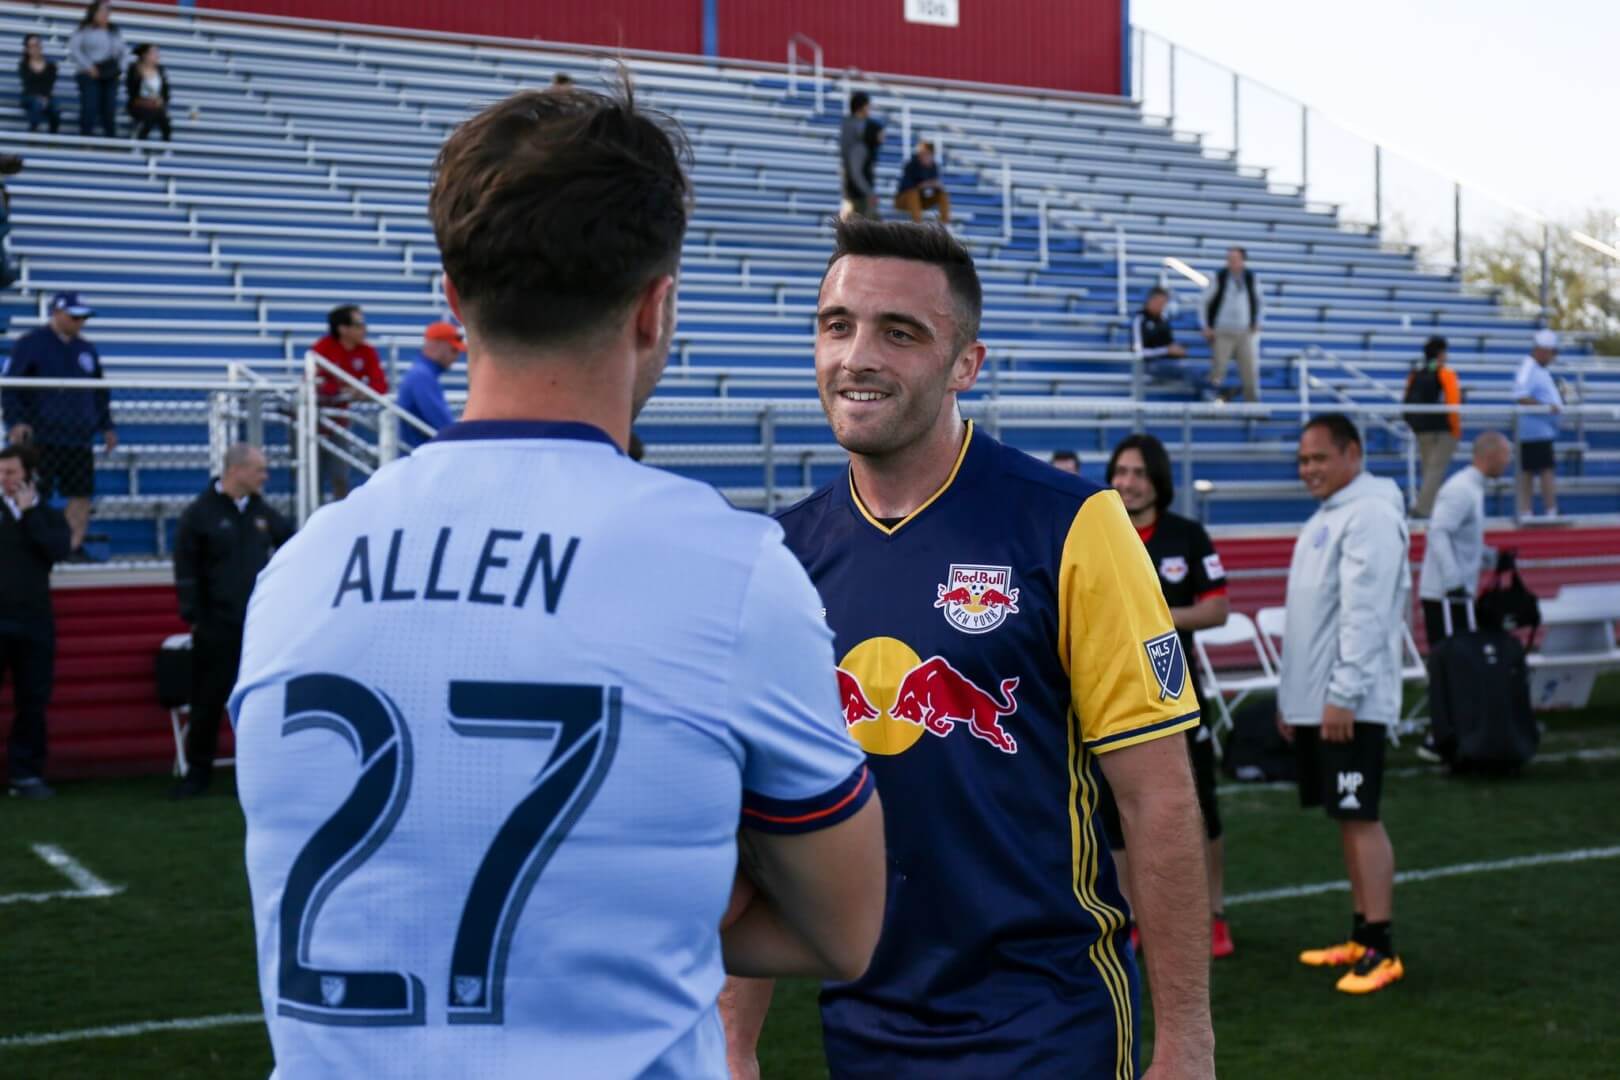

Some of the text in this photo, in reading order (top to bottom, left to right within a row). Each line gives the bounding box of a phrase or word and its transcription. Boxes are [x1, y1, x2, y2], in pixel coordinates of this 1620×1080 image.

[331, 526, 581, 615] ALLEN
[954, 571, 1004, 585] Red Bull
[952, 608, 999, 627] NEW YORK
[1151, 642, 1170, 660] MLS
[1338, 771, 1363, 794] MP
[277, 672, 622, 1027] 27
